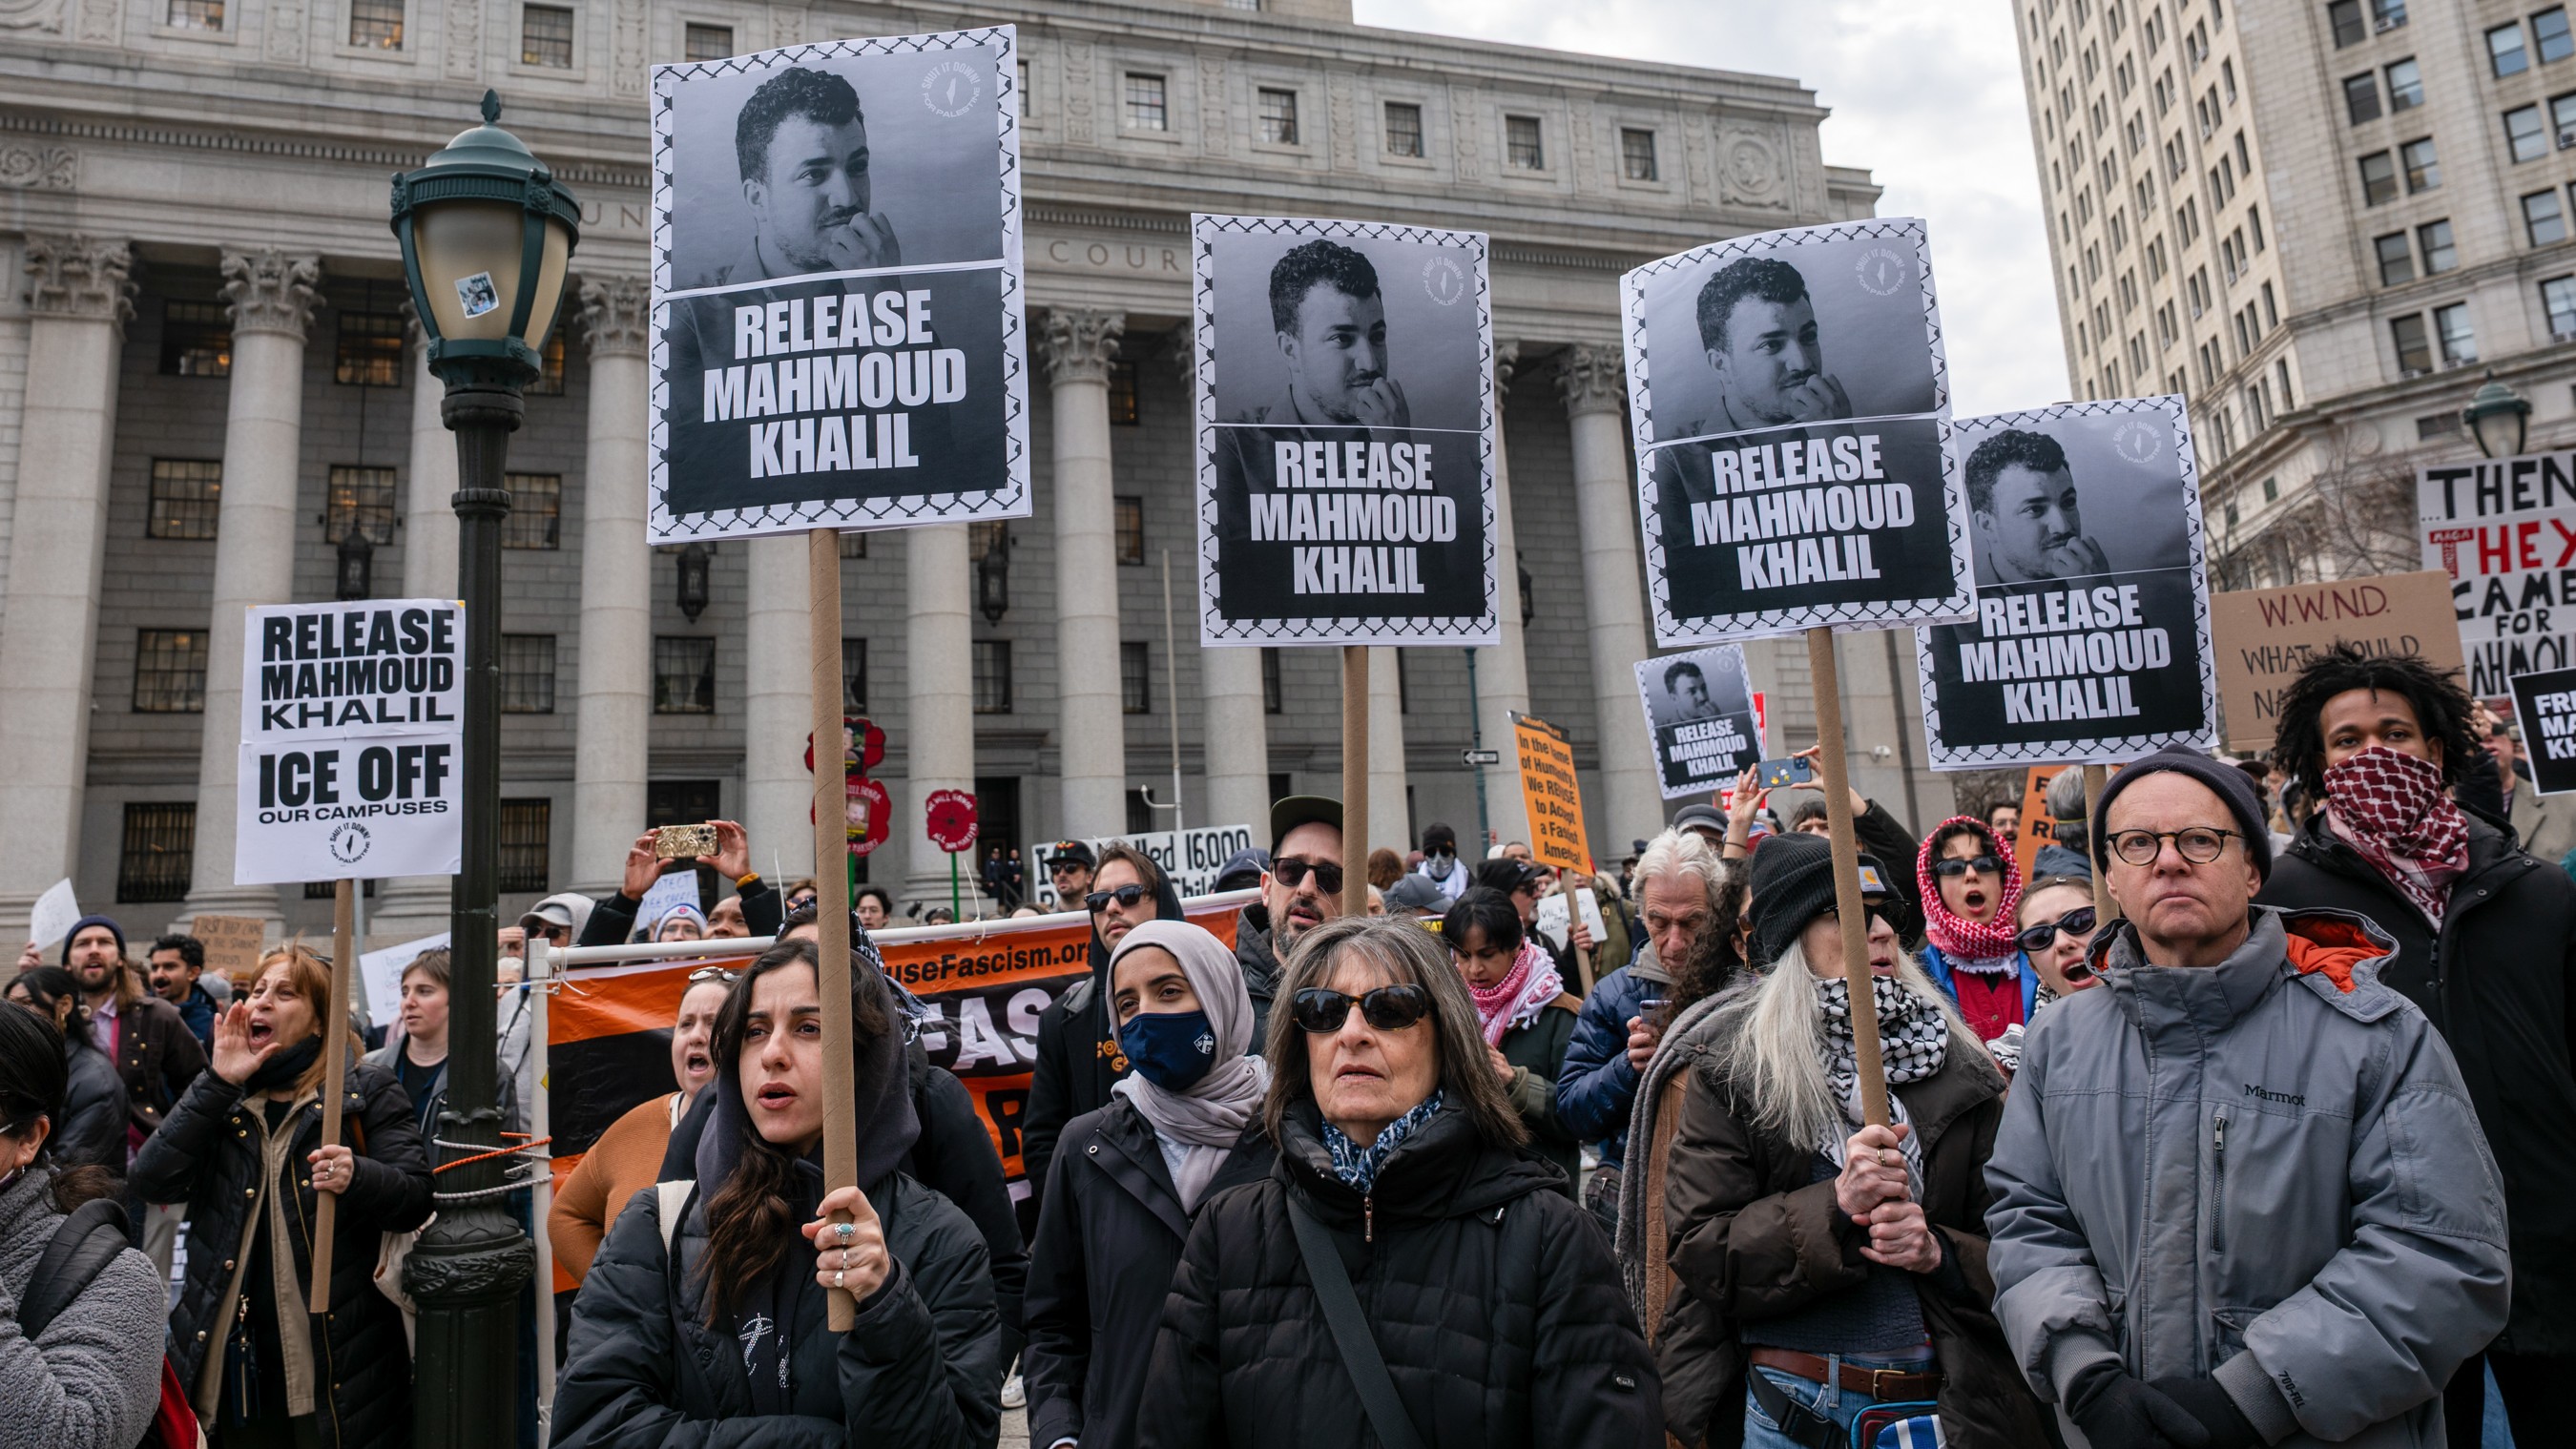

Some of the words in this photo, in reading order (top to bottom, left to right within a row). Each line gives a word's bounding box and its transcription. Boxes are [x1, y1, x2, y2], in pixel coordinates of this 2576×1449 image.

[922, 67, 941, 89] SHUT
[941, 62, 950, 72] IT
[953, 61, 981, 85] DOWN!
[923, 93, 937, 113] FOR
[936, 87, 981, 118] PALESTINE
[1049, 240, 1180, 273] COUR
[1855, 252, 1871, 272] SHUT
[1870, 248, 1879, 259] IT
[1857, 274, 1871, 292] FOR
[1870, 270, 1906, 296] PALESTINE
[735, 289, 933, 360] RELEASE
[704, 348, 966, 423] MAHMOUD
[750, 412, 919, 479] KHALIL
[1275, 441, 1433, 490] RELEASE
[1712, 434, 1884, 495] RELEASE
[1249, 493, 1457, 543] MAHMOUD
[1690, 483, 1915, 547] MAHMOUD
[1736, 534, 1880, 591] KHALIL
[2429, 518, 2576, 580] THEY
[1293, 547, 1425, 594] KHALIL
[1979, 584, 2143, 638] RELEASE
[2452, 569, 2576, 620] CAME
[262, 608, 455, 662] RELEASE
[2496, 609, 2552, 638] FOR
[1959, 627, 2171, 683] MAHMOUD
[2241, 644, 2312, 675] WHAT
[261, 656, 453, 701] MAHMOUD
[261, 696, 455, 731] KHALIL
[2002, 675, 2140, 724] KHALIL
[1519, 733, 1528, 750] In
[1531, 736, 1549, 754] the
[1669, 734, 1748, 763] MAHMOUD
[1674, 718, 1735, 744] RELEASE
[259, 749, 340, 809] ICE
[358, 743, 451, 802] OFF
[1521, 756, 1531, 770] of
[1686, 754, 1738, 777] KHALIL
[1527, 775, 1544, 794] We
[259, 809, 310, 824] OUR
[315, 800, 448, 820] CAMPUSES
[1535, 797, 1547, 815] to
[329, 826, 343, 842] SHUT
[351, 821, 371, 838] DOWN!
[1540, 822, 1547, 836] a
[330, 844, 340, 859] FOR
[339, 840, 370, 863] PALESTINE
[885, 942, 1092, 983] useFascism.or
[2244, 1084, 2306, 1107] Marmot
[2278, 1370, 2306, 1409] 700-FILL
